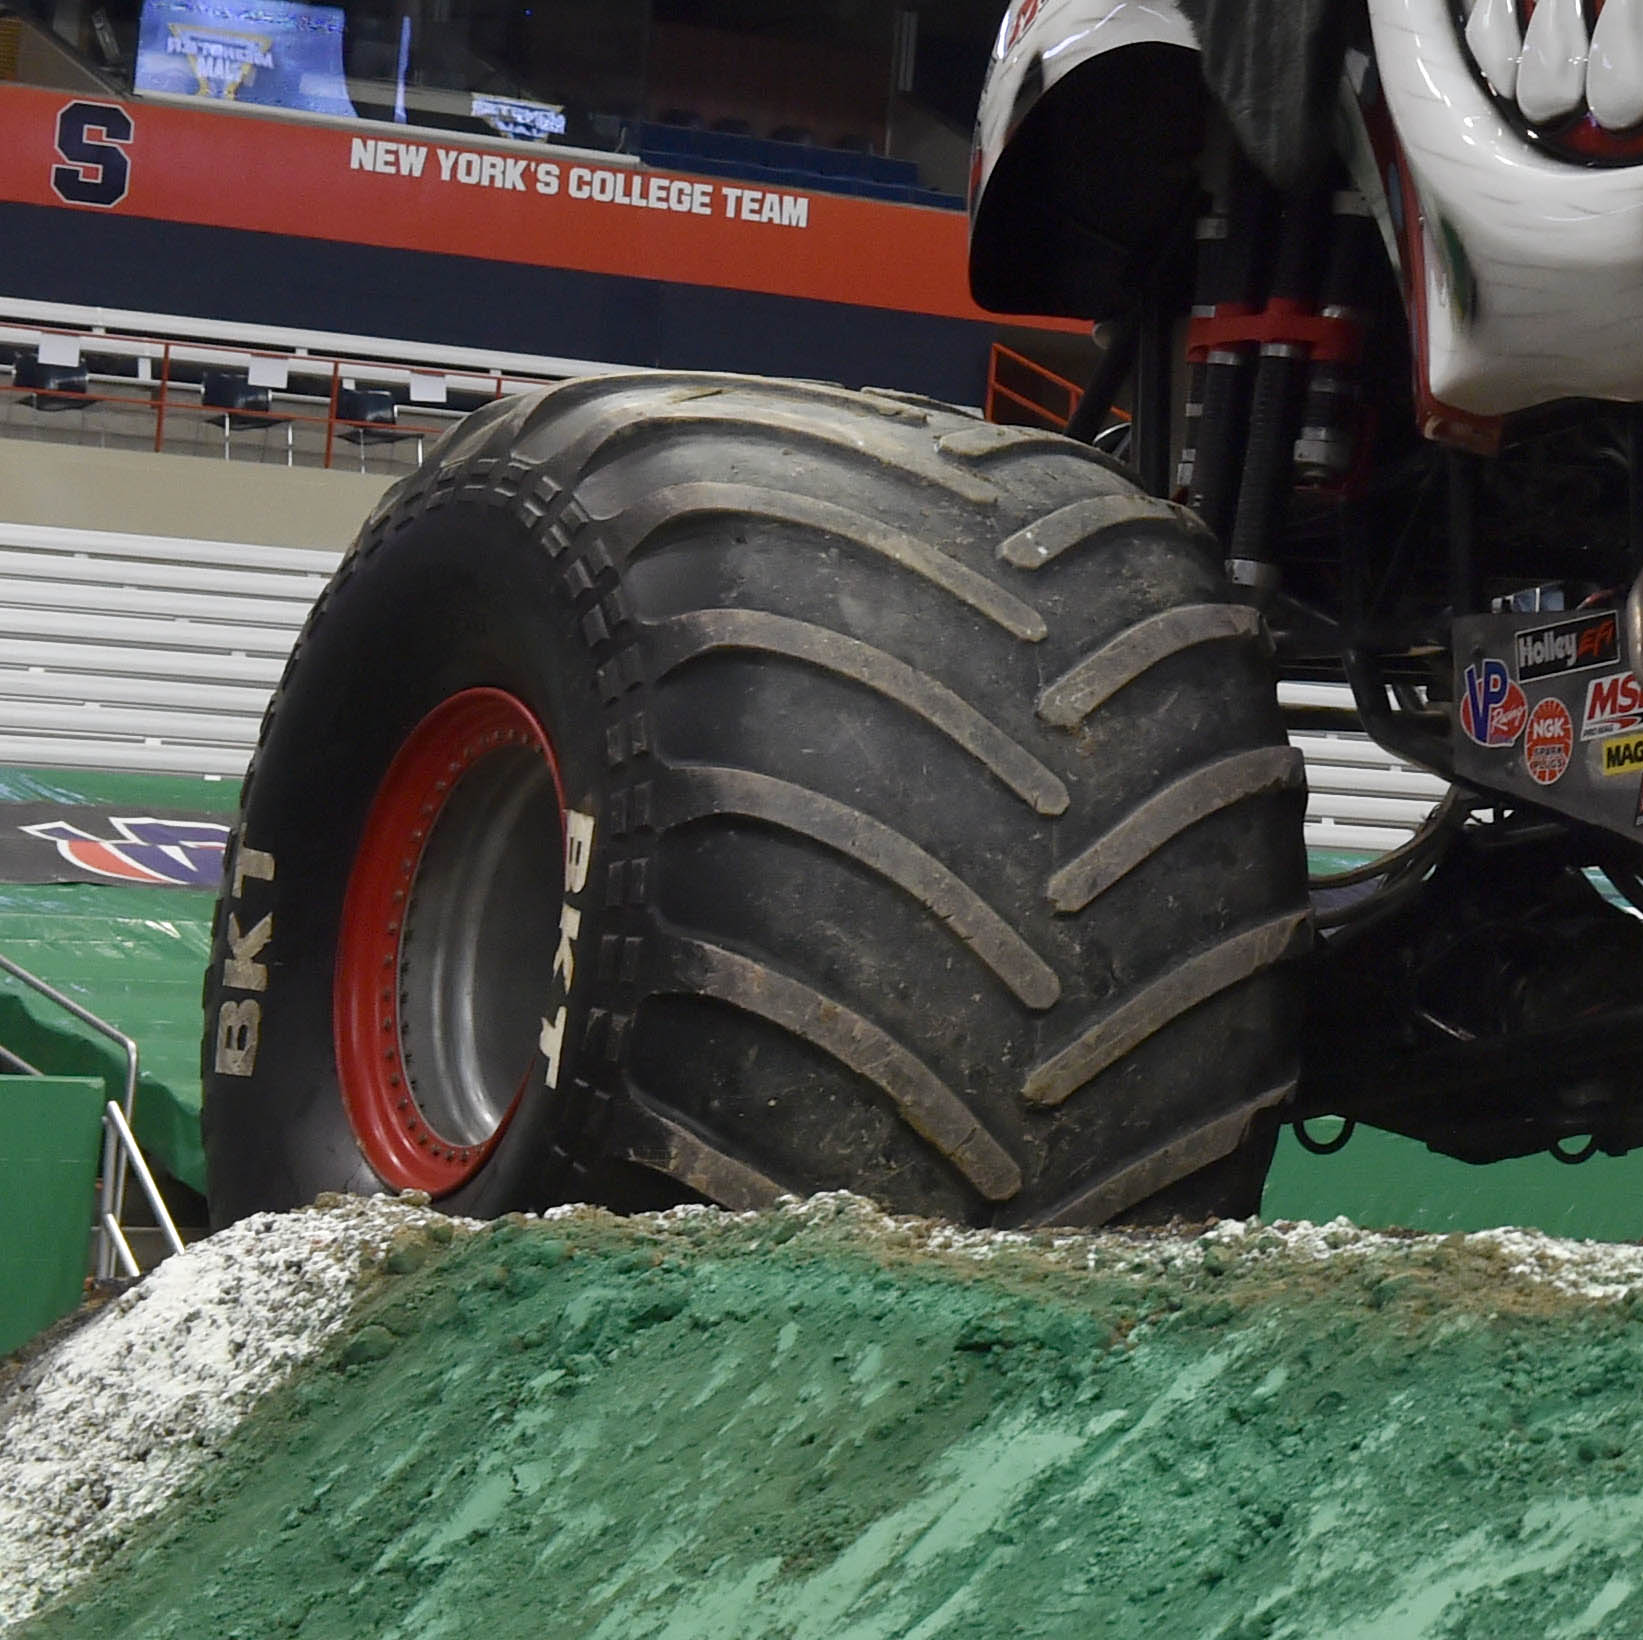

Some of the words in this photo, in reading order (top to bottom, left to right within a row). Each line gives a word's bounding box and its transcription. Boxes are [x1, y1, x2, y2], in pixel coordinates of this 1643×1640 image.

[51, 100, 136, 208] S
[350, 137, 428, 178] NEW
[436, 149, 559, 195] YORK'S
[568, 168, 712, 216] COLLEGE
[722, 186, 809, 228] TEAM
[1519, 630, 1577, 667] Holley
[1464, 658, 1509, 745] VP
[1532, 718, 1565, 739] NGK
[215, 830, 276, 1077] BKT
[538, 808, 596, 1090] BKT
